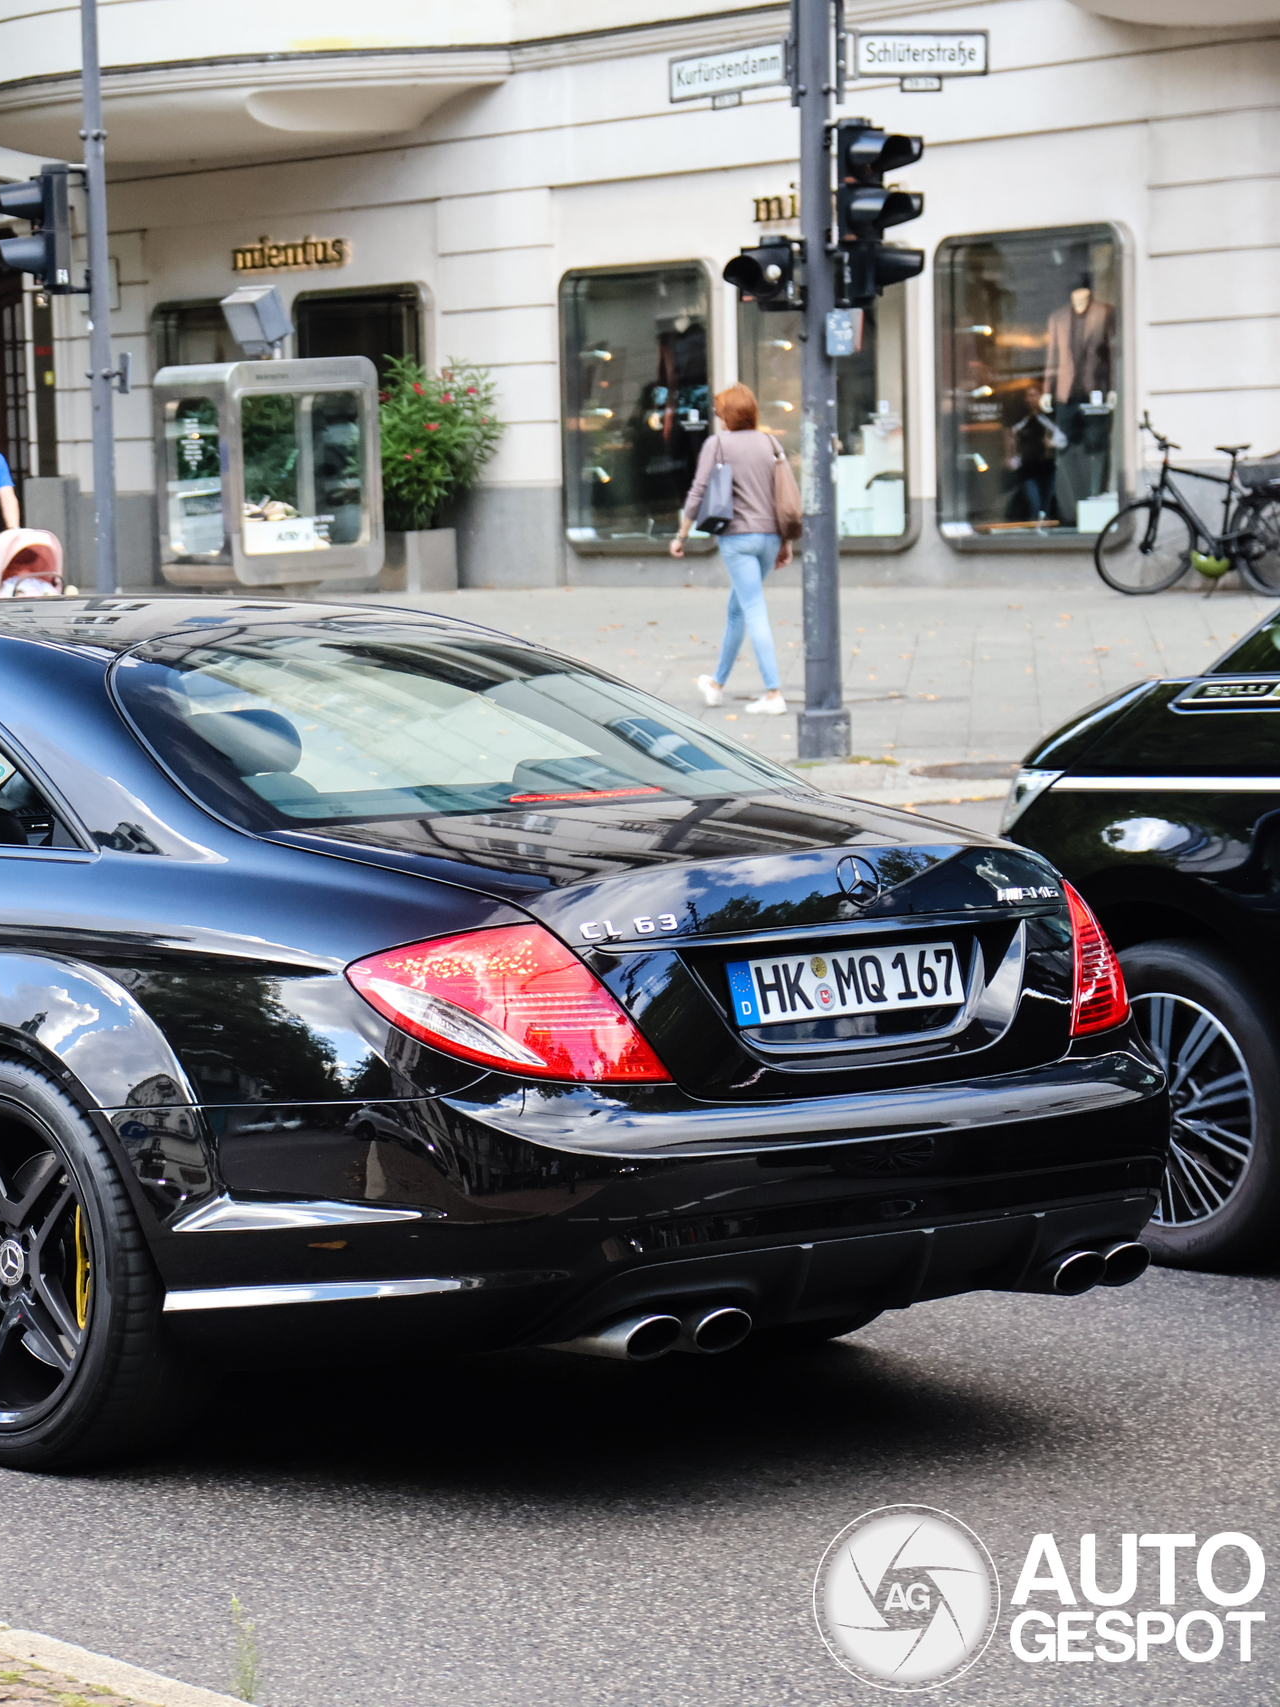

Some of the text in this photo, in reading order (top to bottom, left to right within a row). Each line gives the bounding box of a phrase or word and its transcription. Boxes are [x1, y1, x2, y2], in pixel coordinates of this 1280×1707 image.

[866, 40, 977, 66] Schlüterstraße
[676, 54, 781, 86] Kurfürstendamm
[231, 235, 344, 270] mientus
[579, 913, 679, 940] CL 63
[754, 948, 954, 1015] HK MQ 167
[741, 1001, 753, 1016] D
